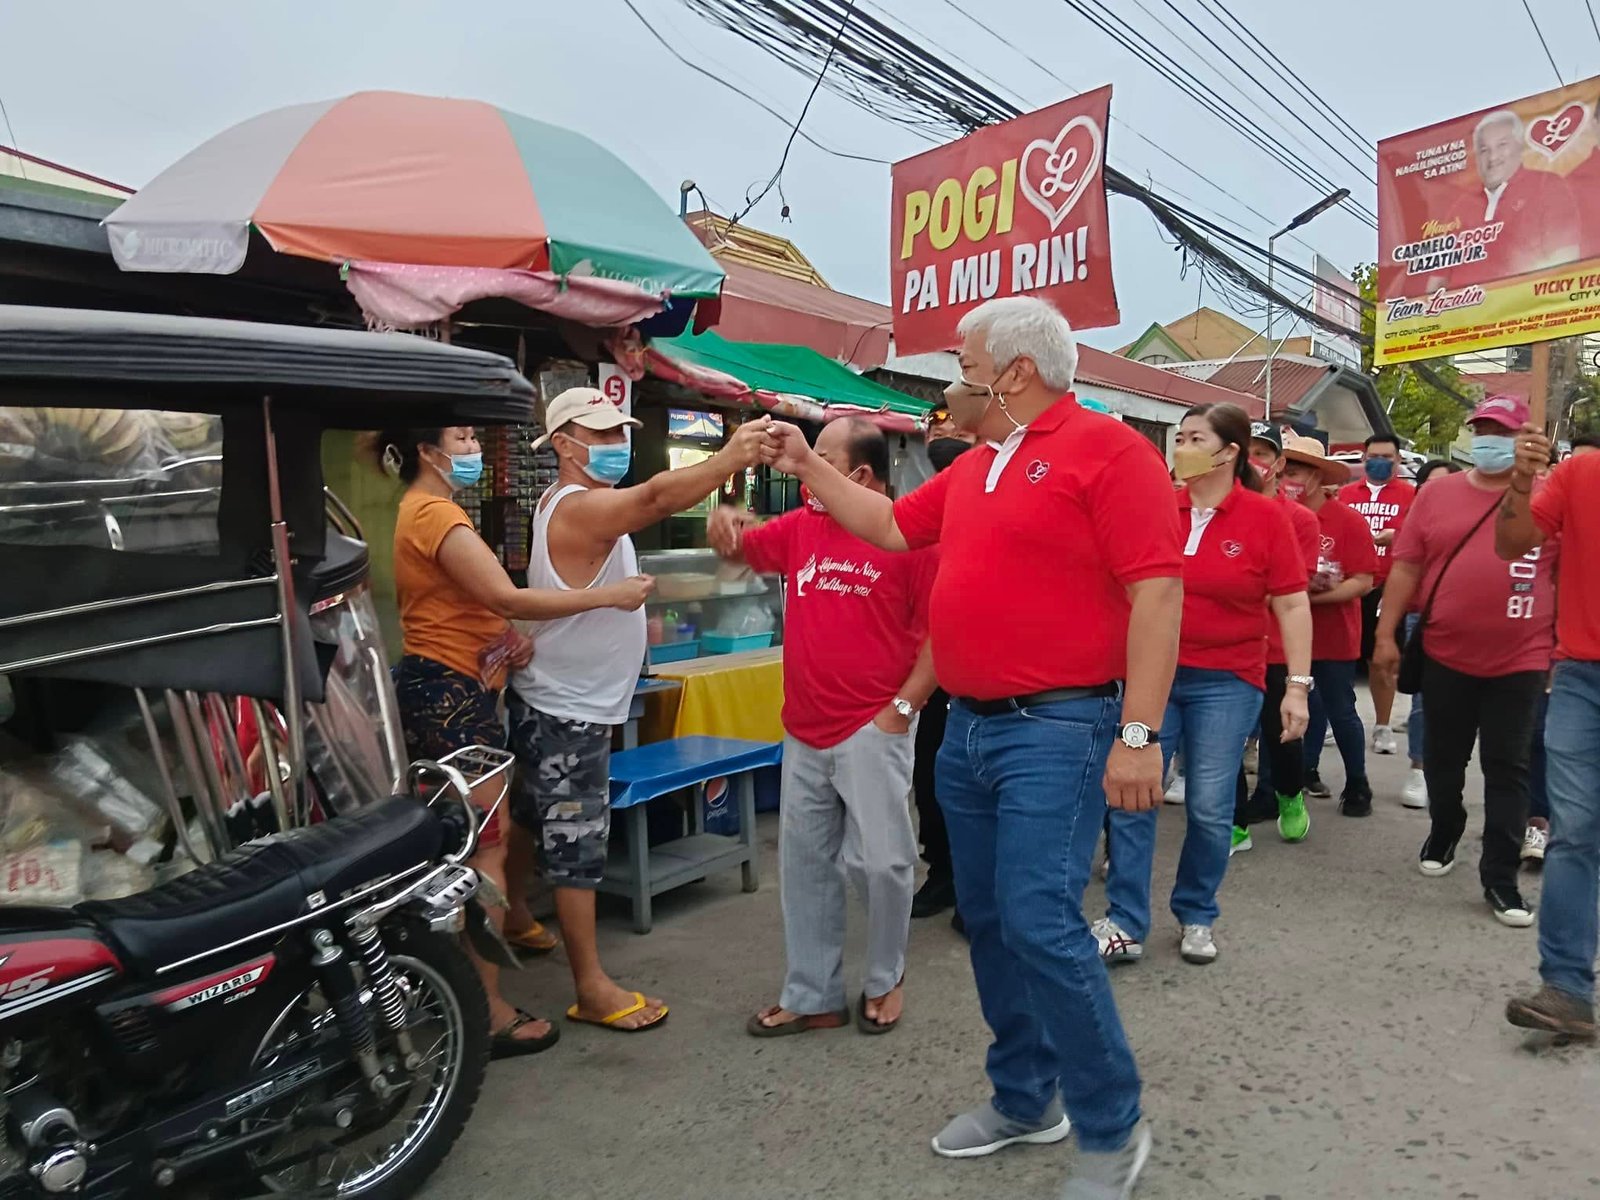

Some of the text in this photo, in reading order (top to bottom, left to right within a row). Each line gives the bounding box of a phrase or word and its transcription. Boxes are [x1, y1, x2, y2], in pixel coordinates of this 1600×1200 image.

[1416, 139, 1466, 160] TUNAY NA
[1423, 168, 1438, 180] SA
[900, 158, 1018, 260] POGI
[1421, 216, 1462, 239] Mayor
[1394, 235, 1455, 261] CARMELO
[1408, 245, 1487, 275] LAZATIN JR.
[902, 225, 1089, 315] PA MU RIN!
[1534, 277, 1575, 296] VICKY
[1569, 290, 1591, 302] CITY
[1387, 286, 1485, 322] Team Lazatin
[1384, 331, 1398, 340] CITY
[187, 972, 253, 1005] WIZARD
